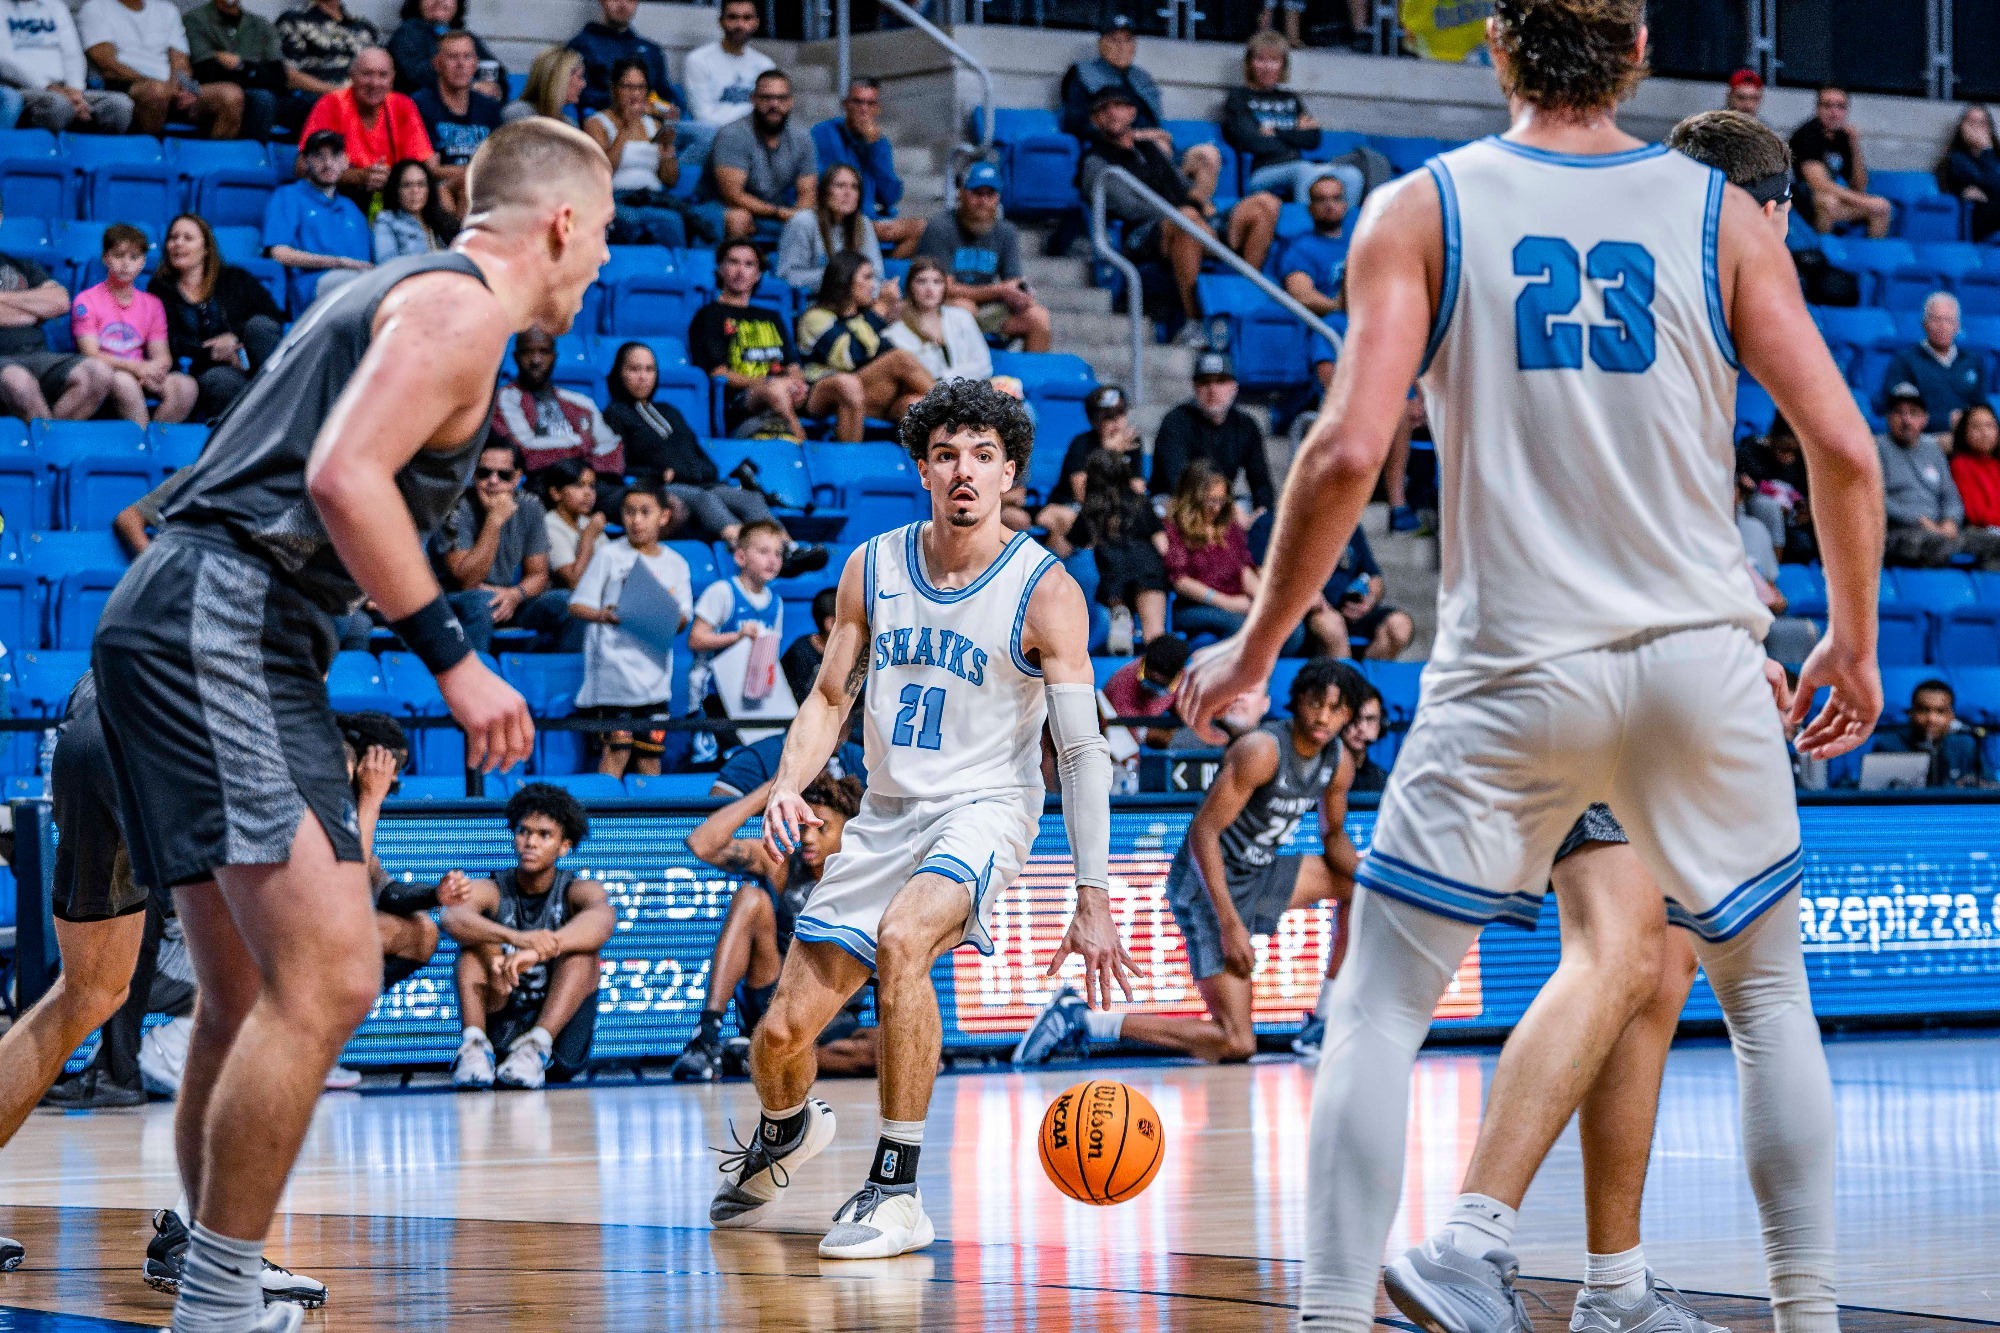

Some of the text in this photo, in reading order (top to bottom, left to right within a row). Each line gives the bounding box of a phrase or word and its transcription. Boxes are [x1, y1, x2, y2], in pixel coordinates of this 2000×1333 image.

[1512, 234, 1656, 374] 23
[892, 683, 947, 750] 21
[1799, 884, 2000, 954] azepizza.
[1053, 1094, 1074, 1150] NCAA
[1087, 1085, 1117, 1160] Wilson
